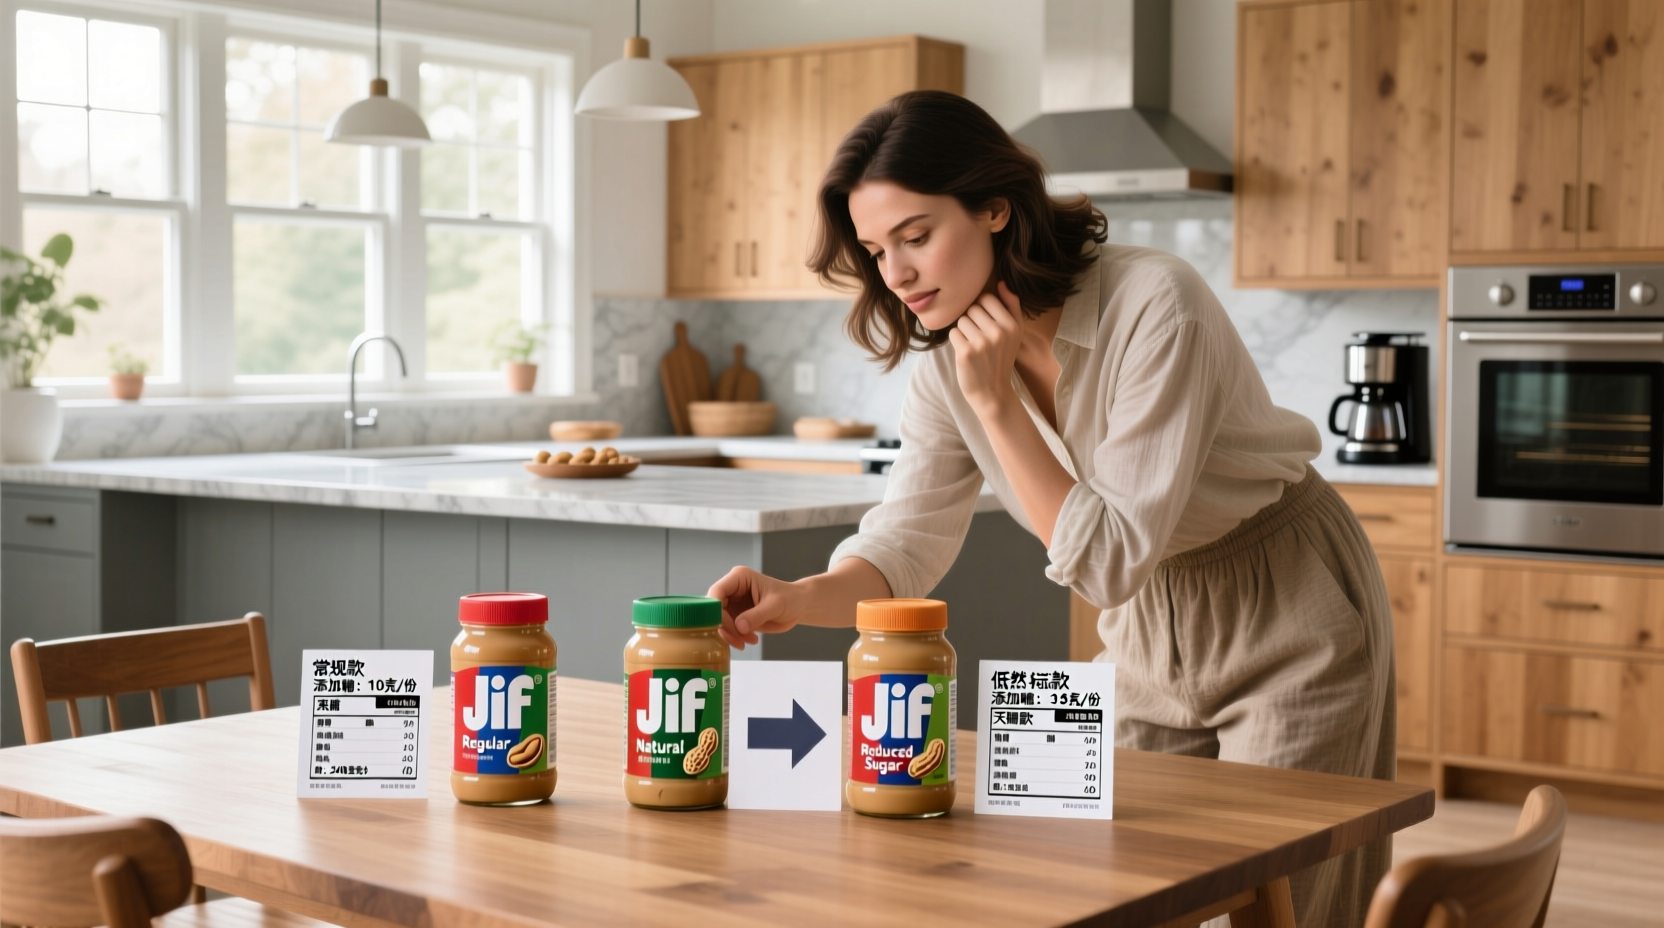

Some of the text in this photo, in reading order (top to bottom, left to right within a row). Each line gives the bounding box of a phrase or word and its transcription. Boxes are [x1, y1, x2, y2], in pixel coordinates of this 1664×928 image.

[462, 674, 534, 732] Jif
[636, 677, 708, 735] Jif
[861, 682, 934, 741] Jif
[462, 735, 511, 753] Regular
[636, 738, 684, 754] Natural
[861, 743, 913, 759] Reduced
[864, 759, 904, 775] Sugar
